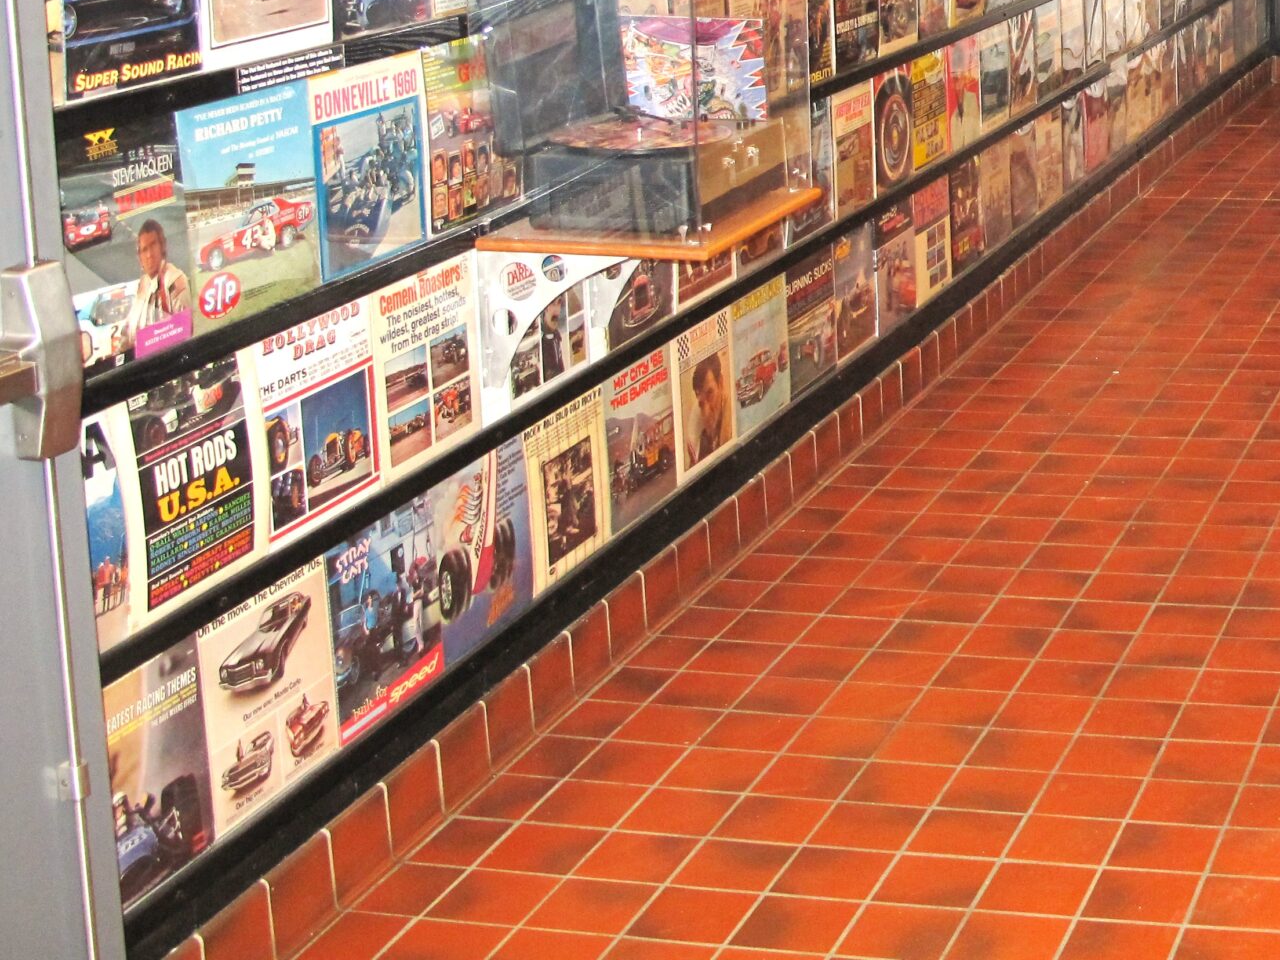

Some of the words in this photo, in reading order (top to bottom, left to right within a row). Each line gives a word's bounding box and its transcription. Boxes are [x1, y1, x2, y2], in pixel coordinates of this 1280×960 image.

[75, 66, 118, 91] SUPER
[121, 55, 164, 80] SOUND
[314, 75, 390, 121] BONNEVILLE
[394, 67, 417, 96] 1960
[194, 116, 249, 142] RICHARD
[249, 107, 284, 128] PETTY
[112, 164, 135, 188] STEVE
[135, 153, 173, 181] McQUEEN
[297, 205, 311, 221] STP
[204, 273, 236, 313] STP
[380, 281, 418, 317] Cement
[418, 260, 465, 299] Roasters!
[784, 271, 813, 298] BURNING
[379, 323, 411, 344] wildest,
[410, 307, 440, 332] greatest
[442, 295, 466, 315] sounds
[386, 314, 401, 327] The
[402, 298, 434, 321] noisiest,
[434, 285, 460, 307] hottest,
[262, 301, 360, 356] HOLLYWOOD
[293, 329, 336, 361] DRAG
[391, 337, 410, 354] from
[410, 333, 423, 344] the
[423, 322, 440, 338] drag
[440, 311, 459, 330] strip!
[277, 367, 307, 390] DARTS
[628, 362, 649, 382] CITY
[610, 395, 627, 410] THE
[155, 451, 189, 497] HOT
[192, 429, 238, 482] RODS
[157, 468, 241, 523] U.S.A.
[336, 537, 373, 573] STRAY
[342, 555, 368, 584] CATS
[197, 625, 210, 639] On
[211, 615, 226, 632] the
[227, 601, 252, 621] move.
[253, 589, 268, 606] The
[268, 567, 306, 596] Chevrolet
[136, 686, 167, 715] RACING
[167, 666, 197, 696] THEMES
[375, 685, 387, 701] for
[388, 651, 440, 704] speed
[243, 711, 253, 722] Our
